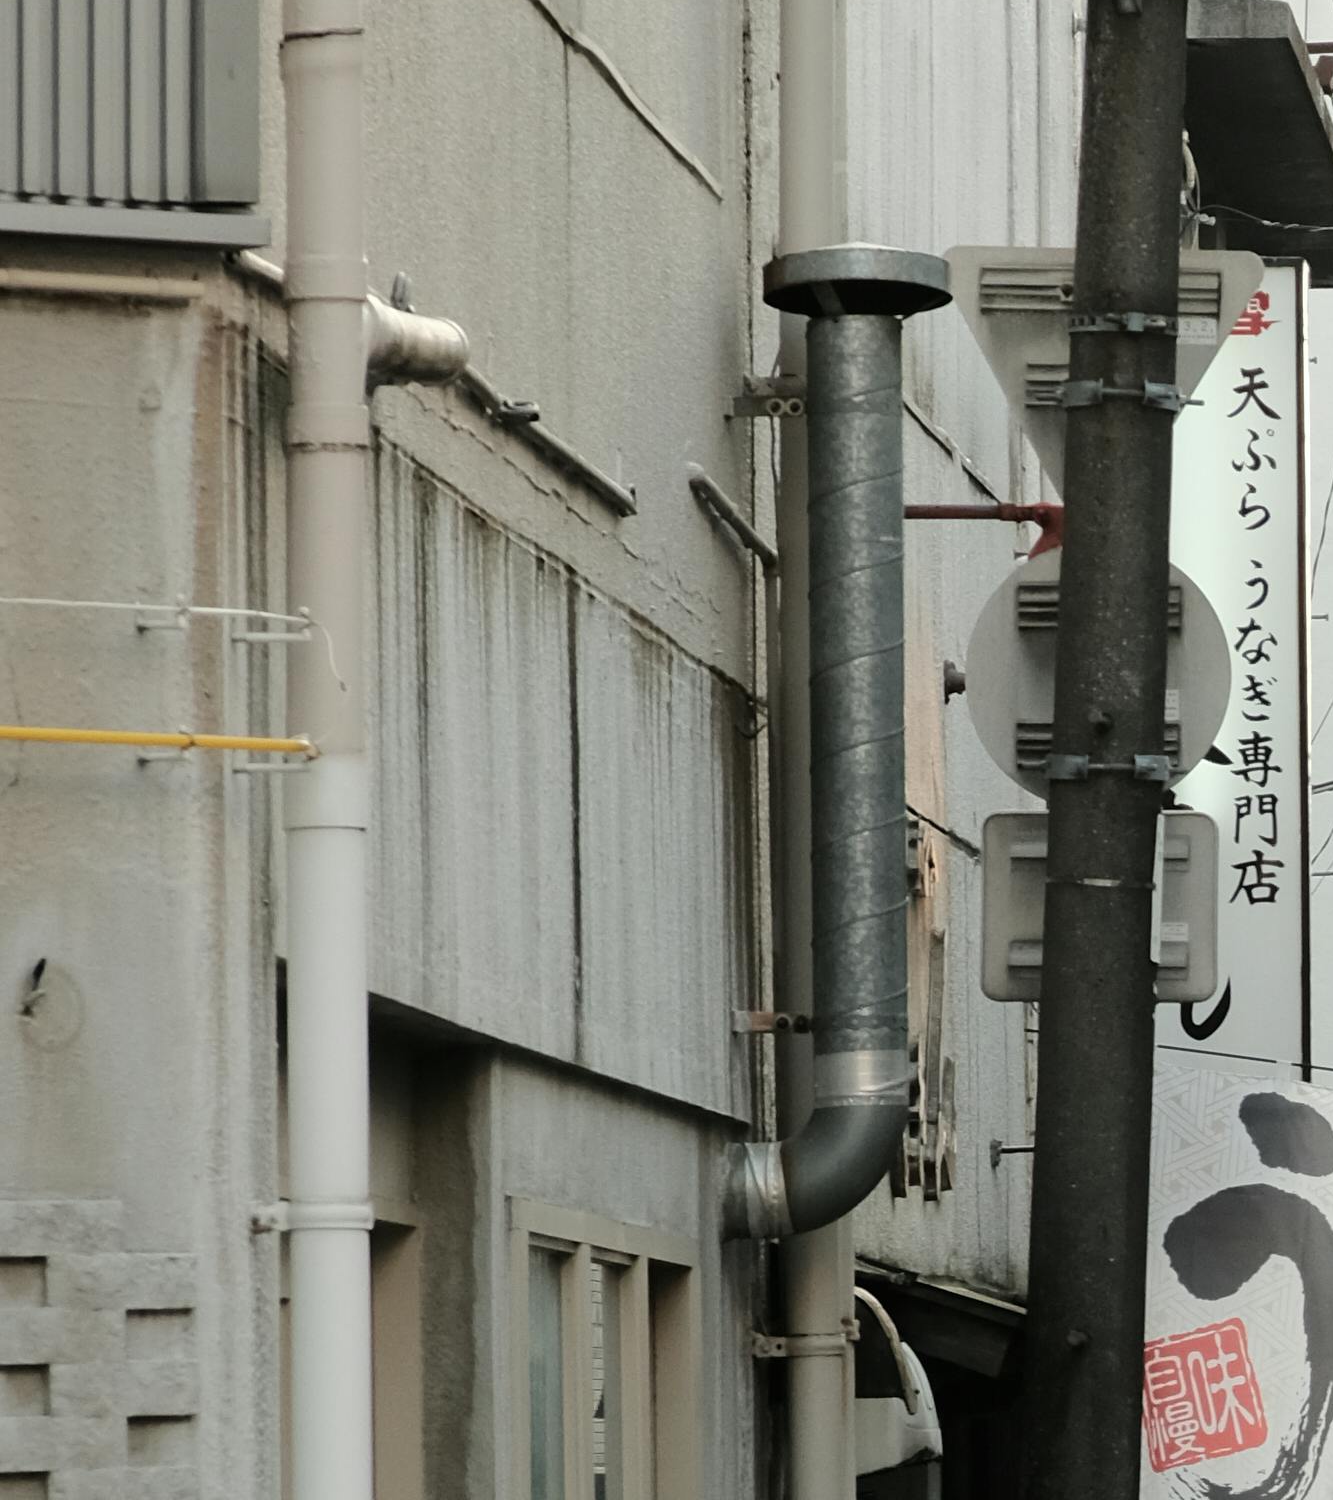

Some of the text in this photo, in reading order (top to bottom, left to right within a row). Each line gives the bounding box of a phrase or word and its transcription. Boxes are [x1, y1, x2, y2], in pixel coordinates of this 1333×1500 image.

[1227, 367, 1281, 531] 天ぷら
[1228, 560, 1286, 906] うなぎ専門店
